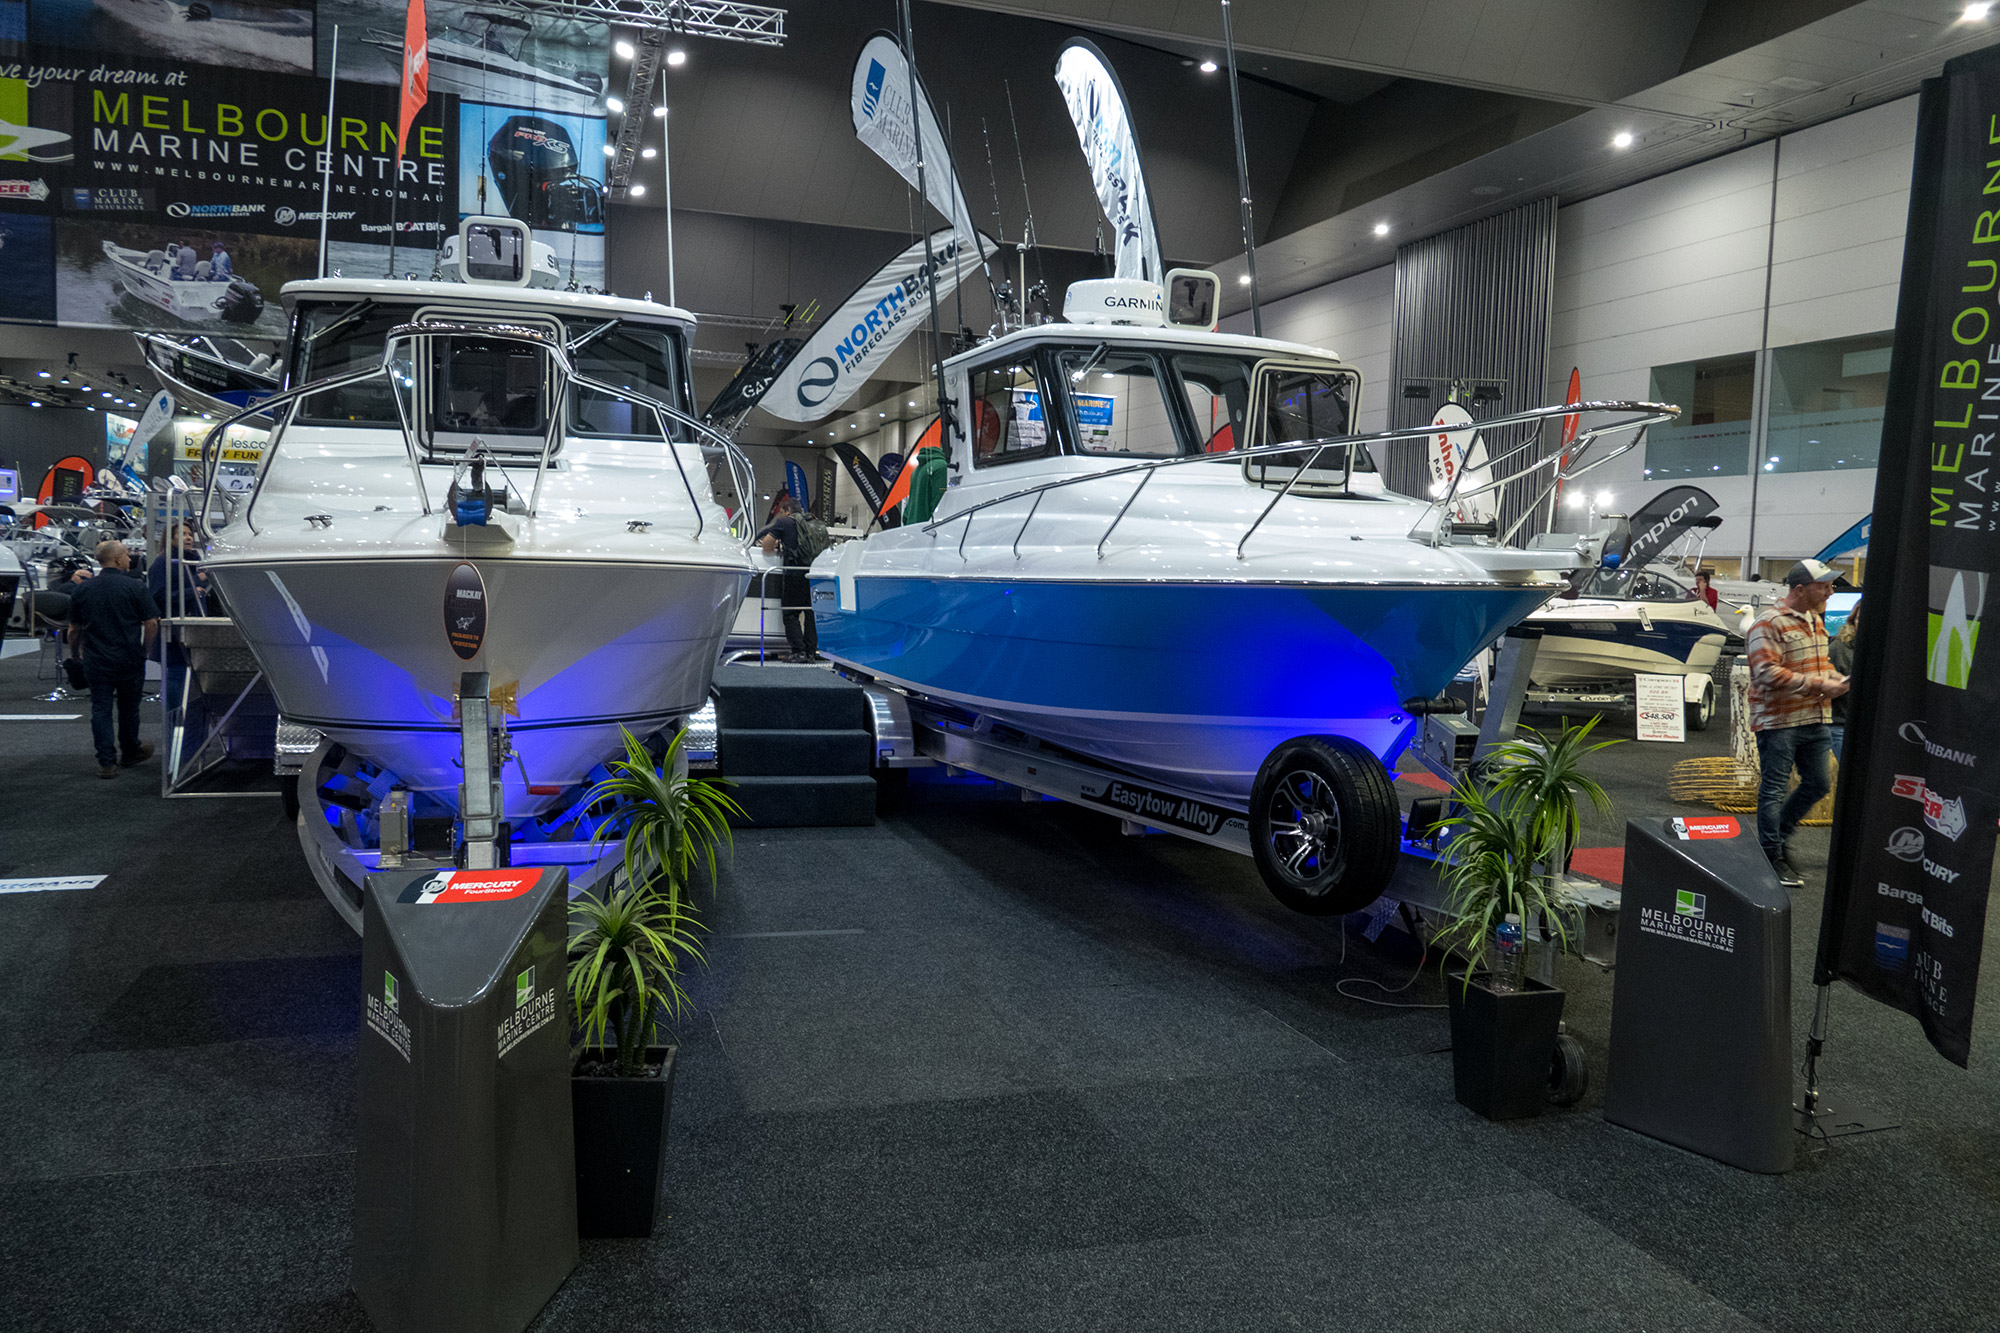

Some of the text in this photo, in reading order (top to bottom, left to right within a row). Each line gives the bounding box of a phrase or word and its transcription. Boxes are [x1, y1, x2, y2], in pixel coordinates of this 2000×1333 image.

[25, 66, 85, 88] your
[89, 64, 159, 85] dream
[165, 70, 188, 86] at
[93, 127, 446, 185] MARINE CENTRE
[93, 160, 444, 202] WWW.MELBOURNEMARNE.COM.AU
[98, 188, 138, 198] CLUB
[94, 197, 144, 205] MARINE
[191, 204, 266, 213] NORTHBANK
[298, 211, 356, 220] MERCURY
[834, 239, 964, 364] NORTHBANK
[844, 274, 942, 374] FIBREGLASS BOAS
[233, 450, 259, 460] FUN
[456, 589, 482, 600] MACKAY
[1110, 782, 1176, 818] Easytow
[1176, 800, 1220, 834] Alloy
[1225, 820, 1248, 831] .com.
[450, 880, 522, 890] MERCURY
[464, 887, 513, 895] FourStroke
[1640, 918, 1735, 947] MARINE CENTRE
[1641, 907, 1735, 939] MELBOURNE
[367, 993, 412, 1044] MELBOURNE
[498, 988, 555, 1040] MELBOURNE
[498, 1002, 555, 1049] MARINE CENTRE
[367, 1009, 412, 1056] MARINE CENTRE
